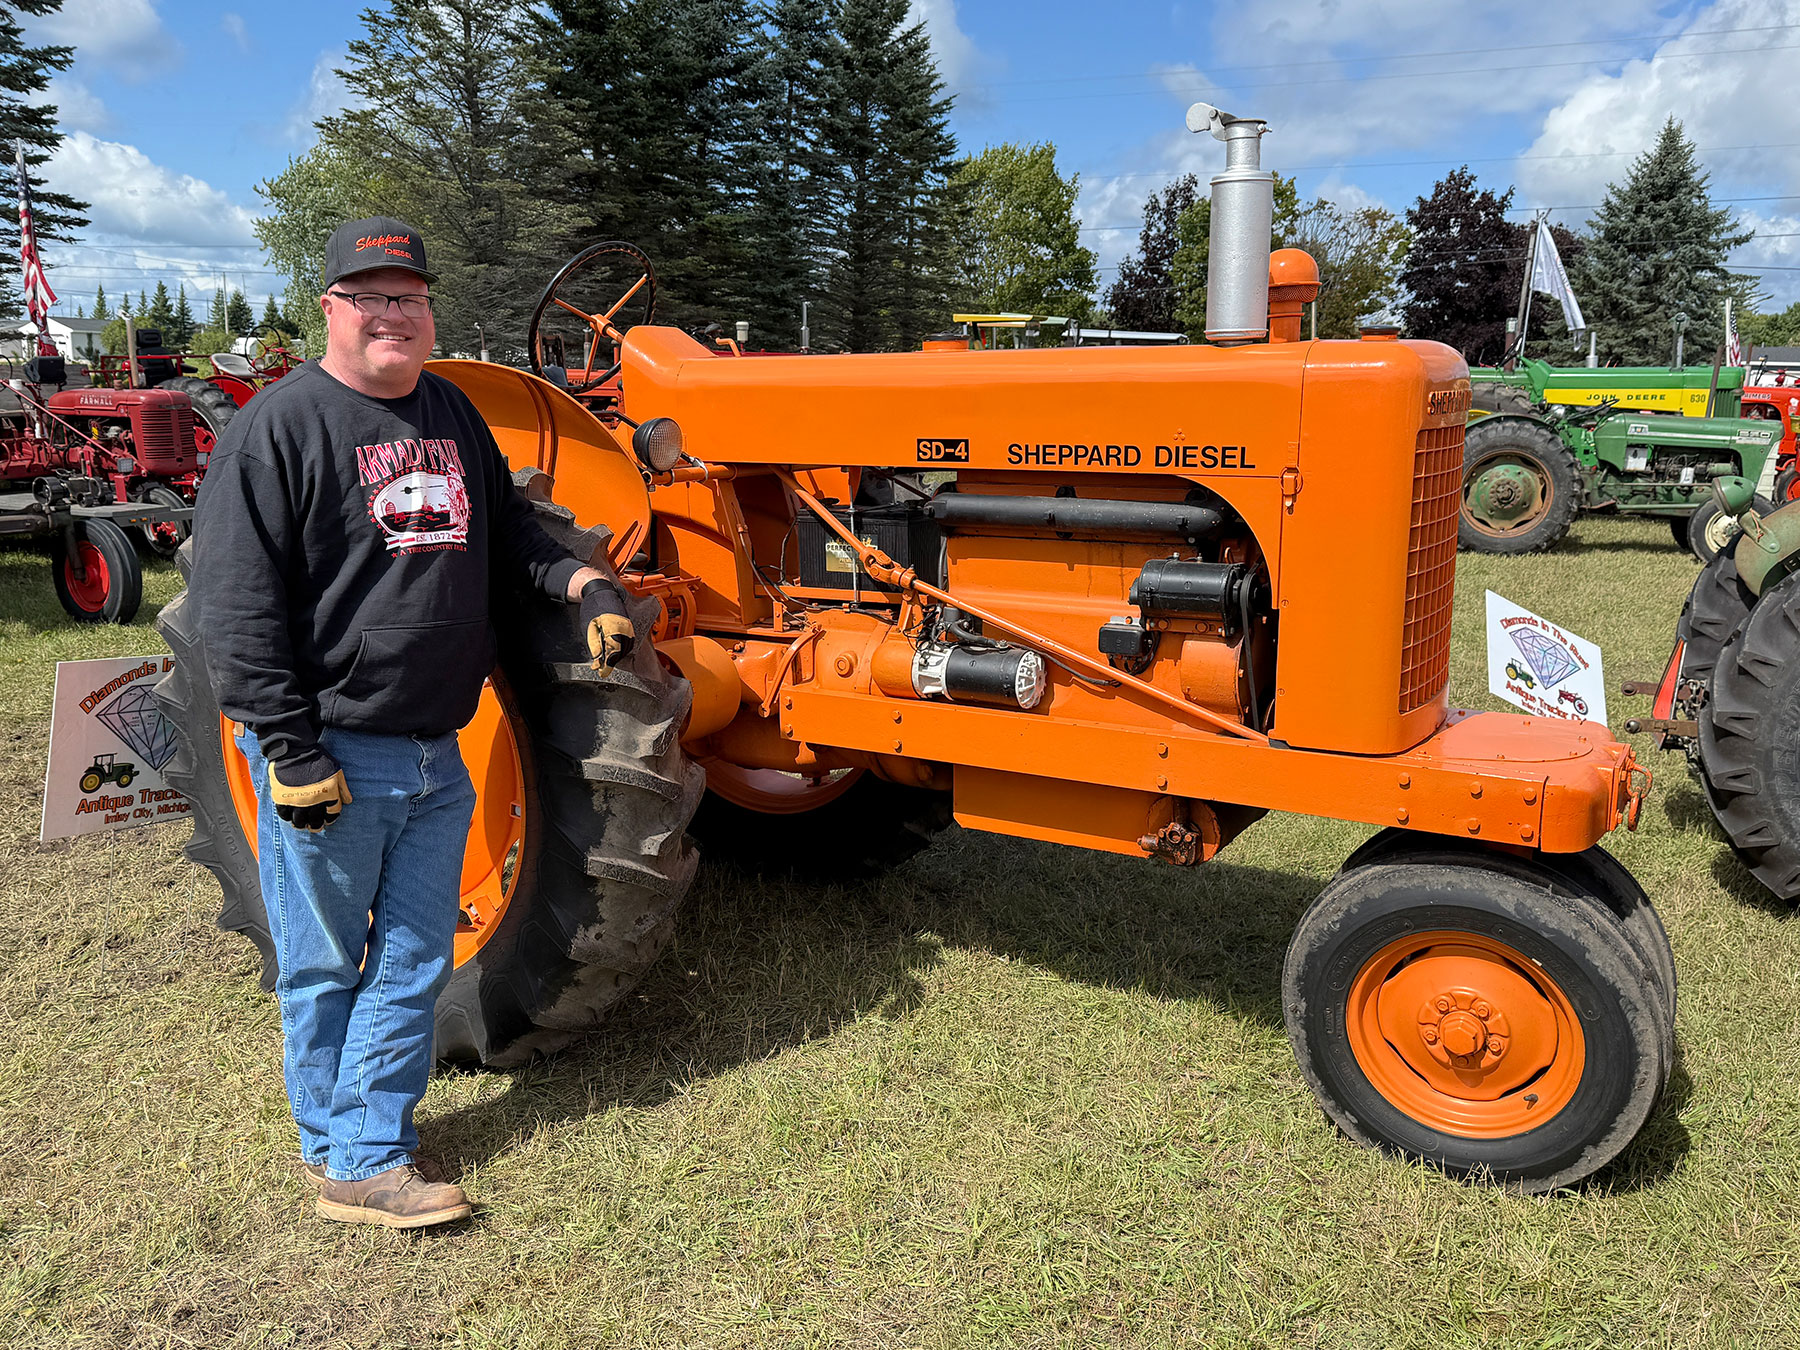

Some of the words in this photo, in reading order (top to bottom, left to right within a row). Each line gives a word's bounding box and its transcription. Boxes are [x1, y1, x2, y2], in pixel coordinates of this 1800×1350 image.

[355, 233, 411, 252] Sheppard
[384, 248, 415, 260] DIESEL
[79, 396, 112, 406] FARMALL
[1690, 394, 1706, 403] 630
[918, 441, 968, 461] SD-4
[1006, 443, 1142, 467] SHEPPARD
[1154, 446, 1256, 469] DIESEL
[429, 532, 451, 542] 1872
[79, 660, 158, 715] Diamonds
[75, 794, 135, 817] Antique
